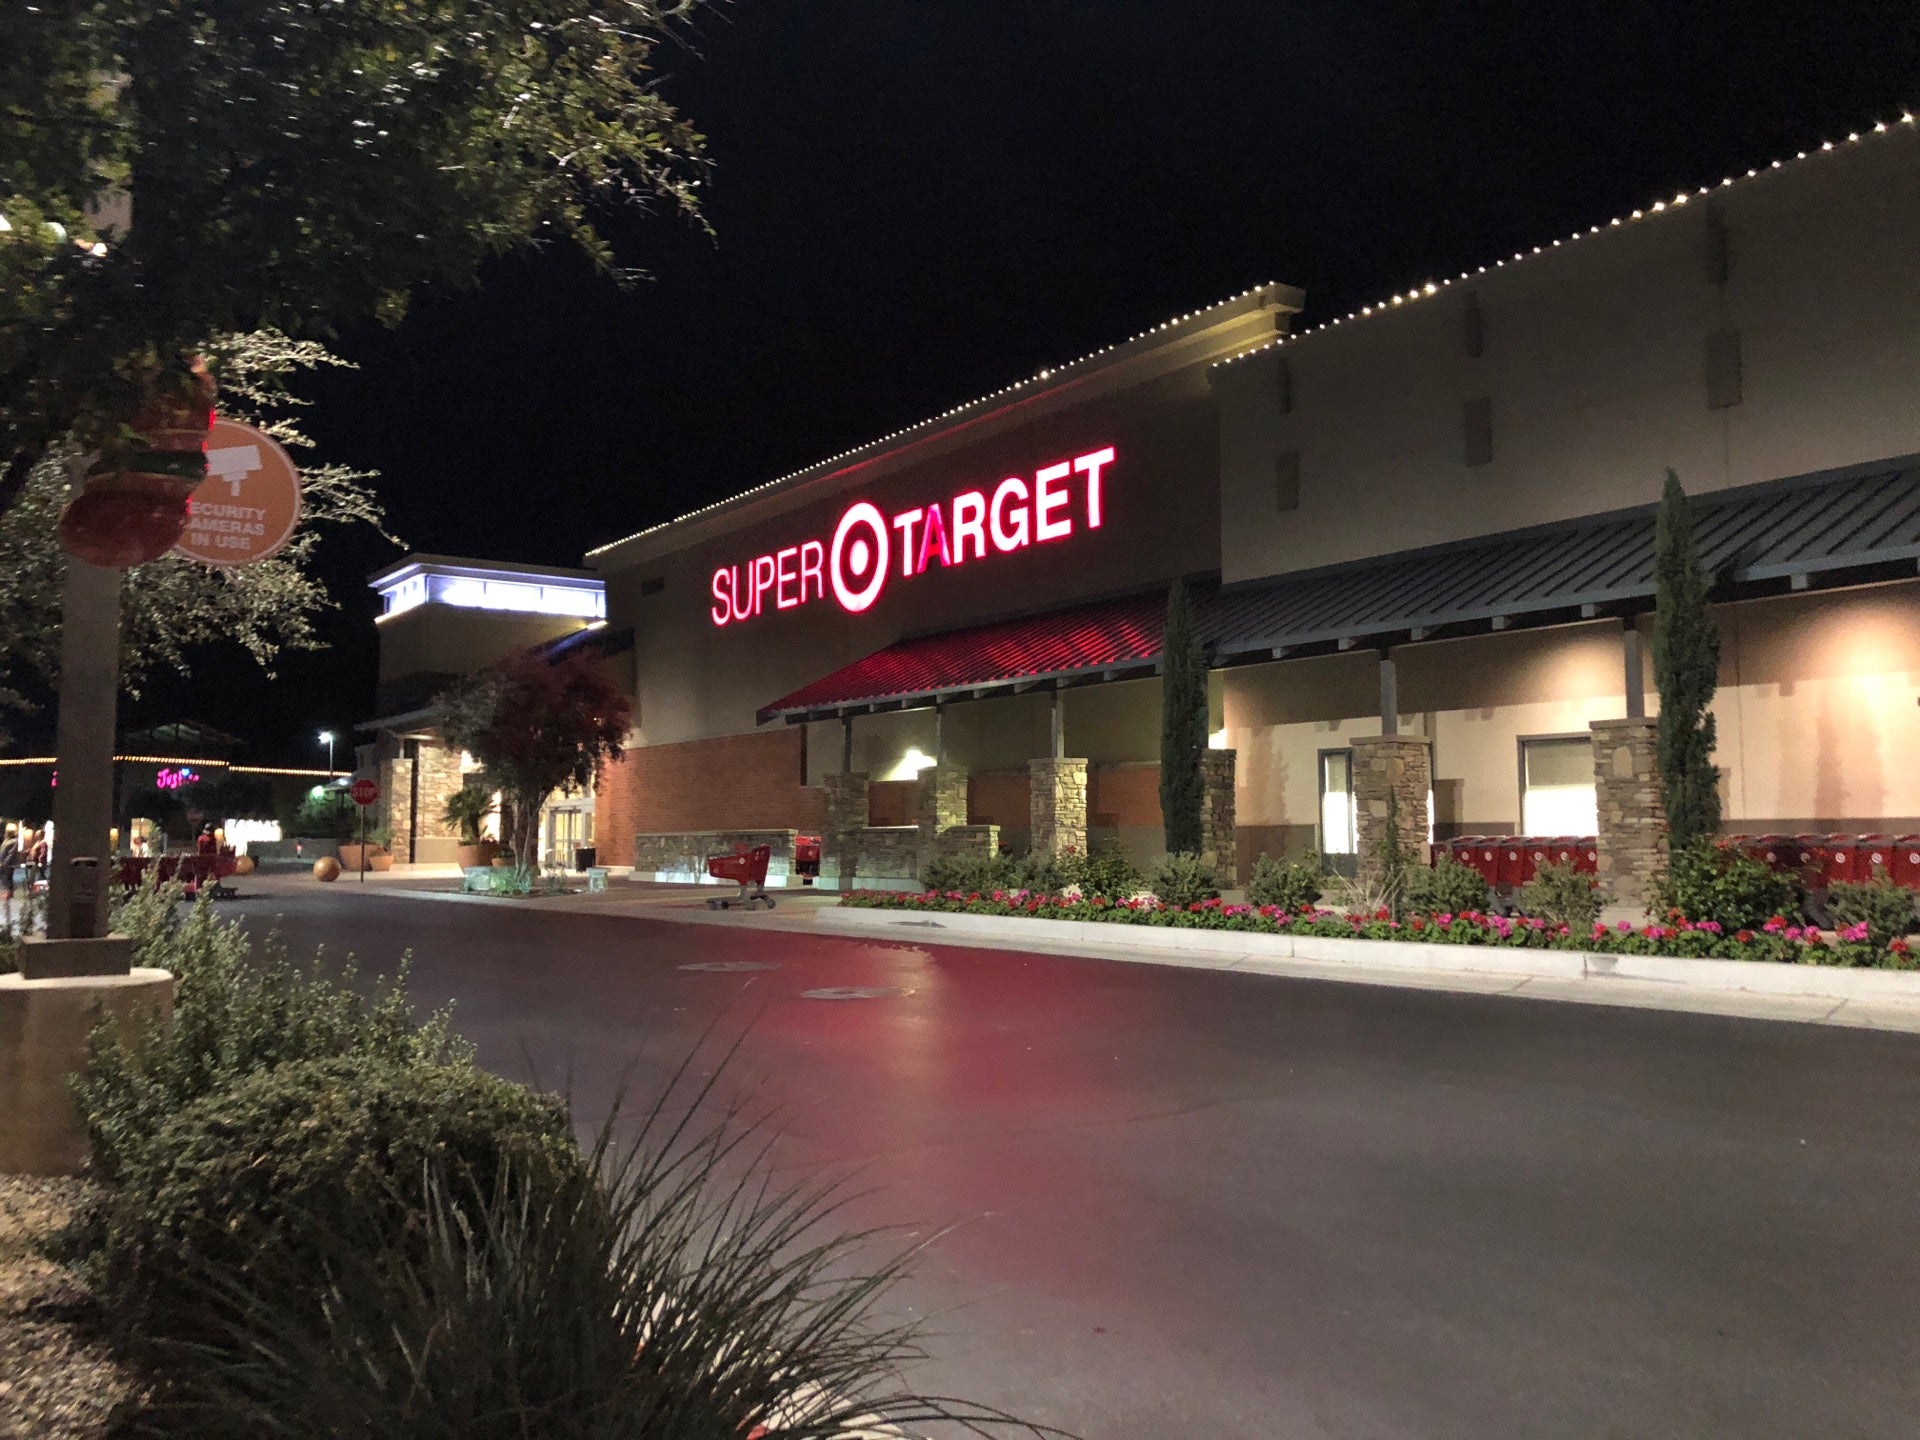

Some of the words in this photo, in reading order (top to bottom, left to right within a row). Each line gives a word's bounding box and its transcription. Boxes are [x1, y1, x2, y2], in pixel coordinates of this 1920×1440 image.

[188, 501, 266, 521] ECURITY
[185, 518, 265, 536] AMERAS
[711, 540, 825, 626] SUPER
[893, 446, 1116, 577] TARGET
[191, 533, 210, 546] IN
[215, 534, 250, 550] USE
[351, 786, 377, 798] STOP
